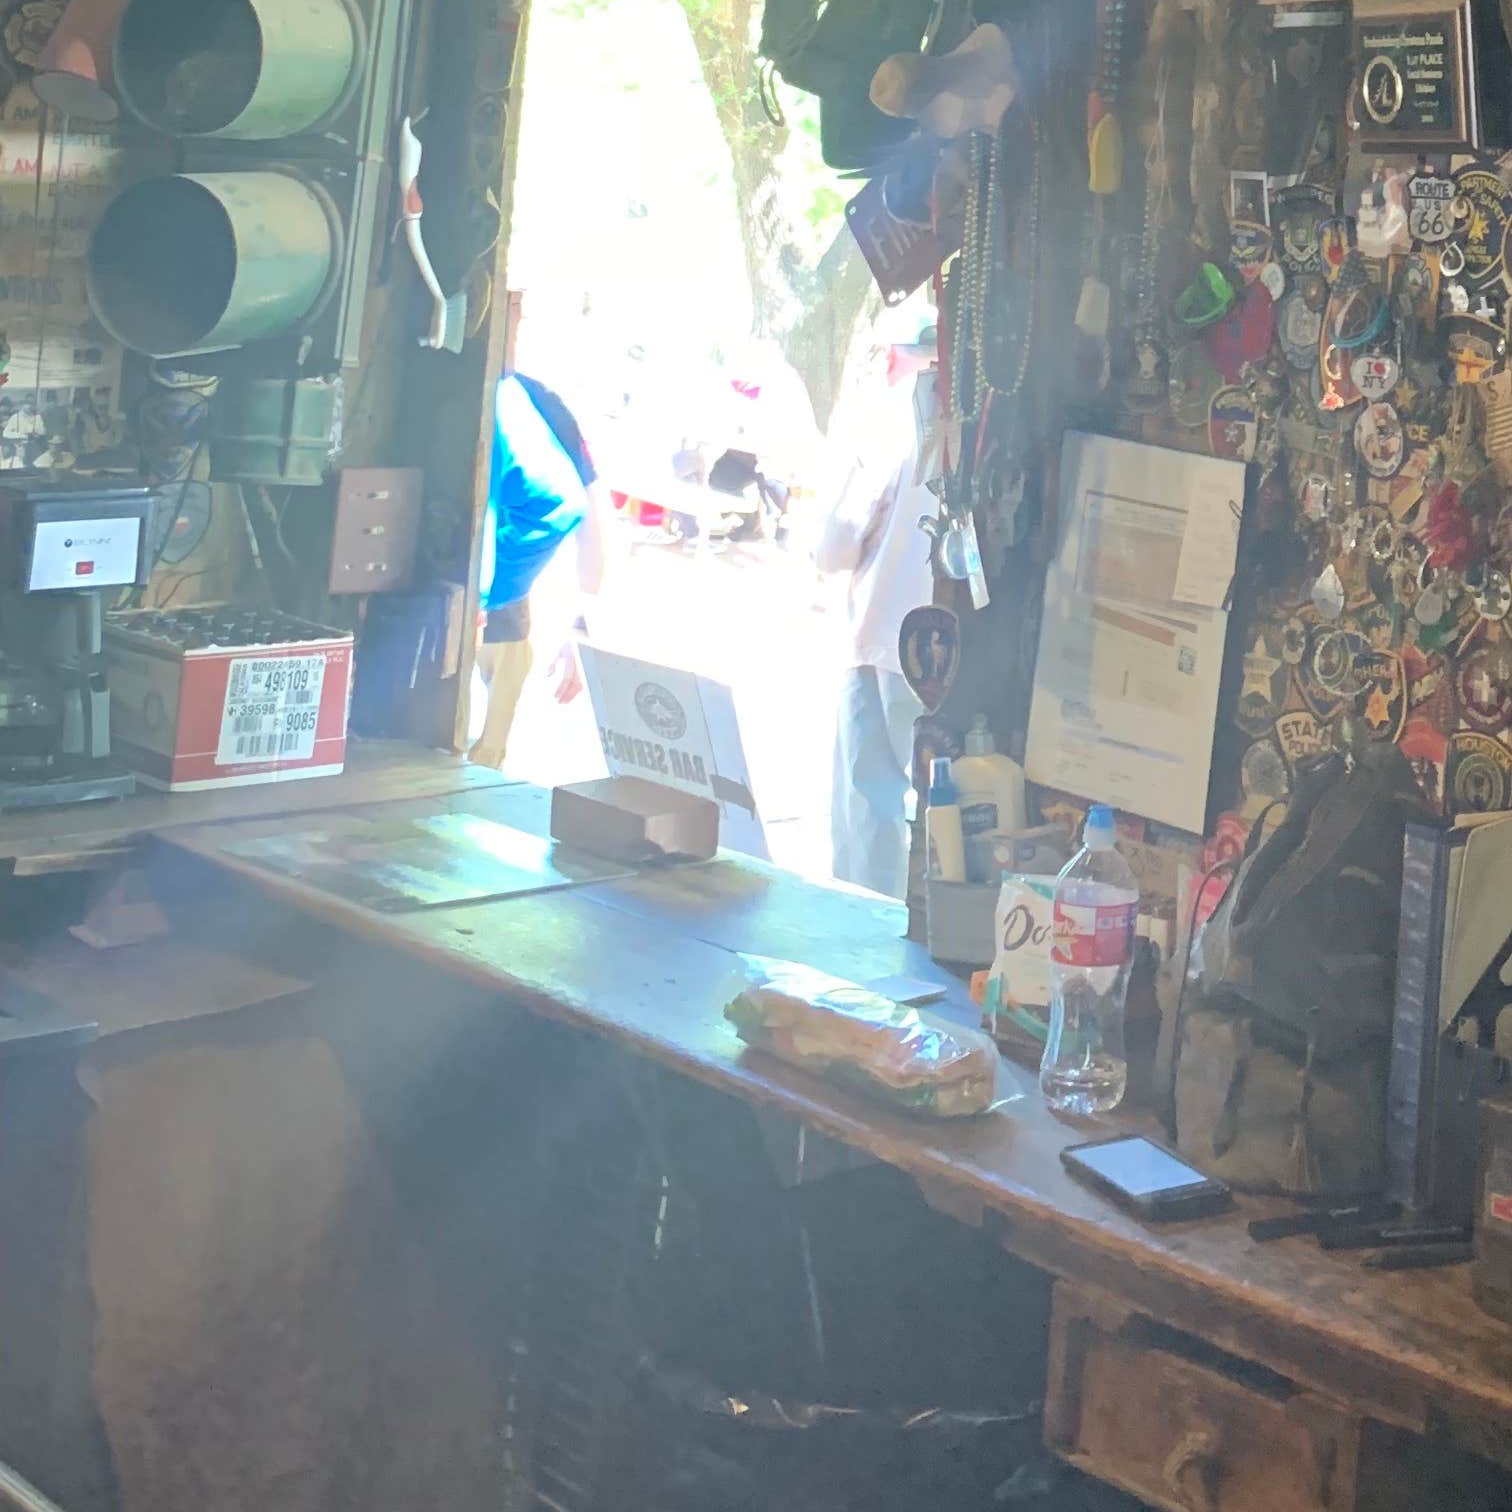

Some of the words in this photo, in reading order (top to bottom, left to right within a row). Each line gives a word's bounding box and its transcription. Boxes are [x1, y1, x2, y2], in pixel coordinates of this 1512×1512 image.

[1415, 182, 1450, 197] ROUTE
[1417, 211, 1445, 235] 66
[1362, 375, 1385, 388] NY
[286, 711, 316, 732] 9085
